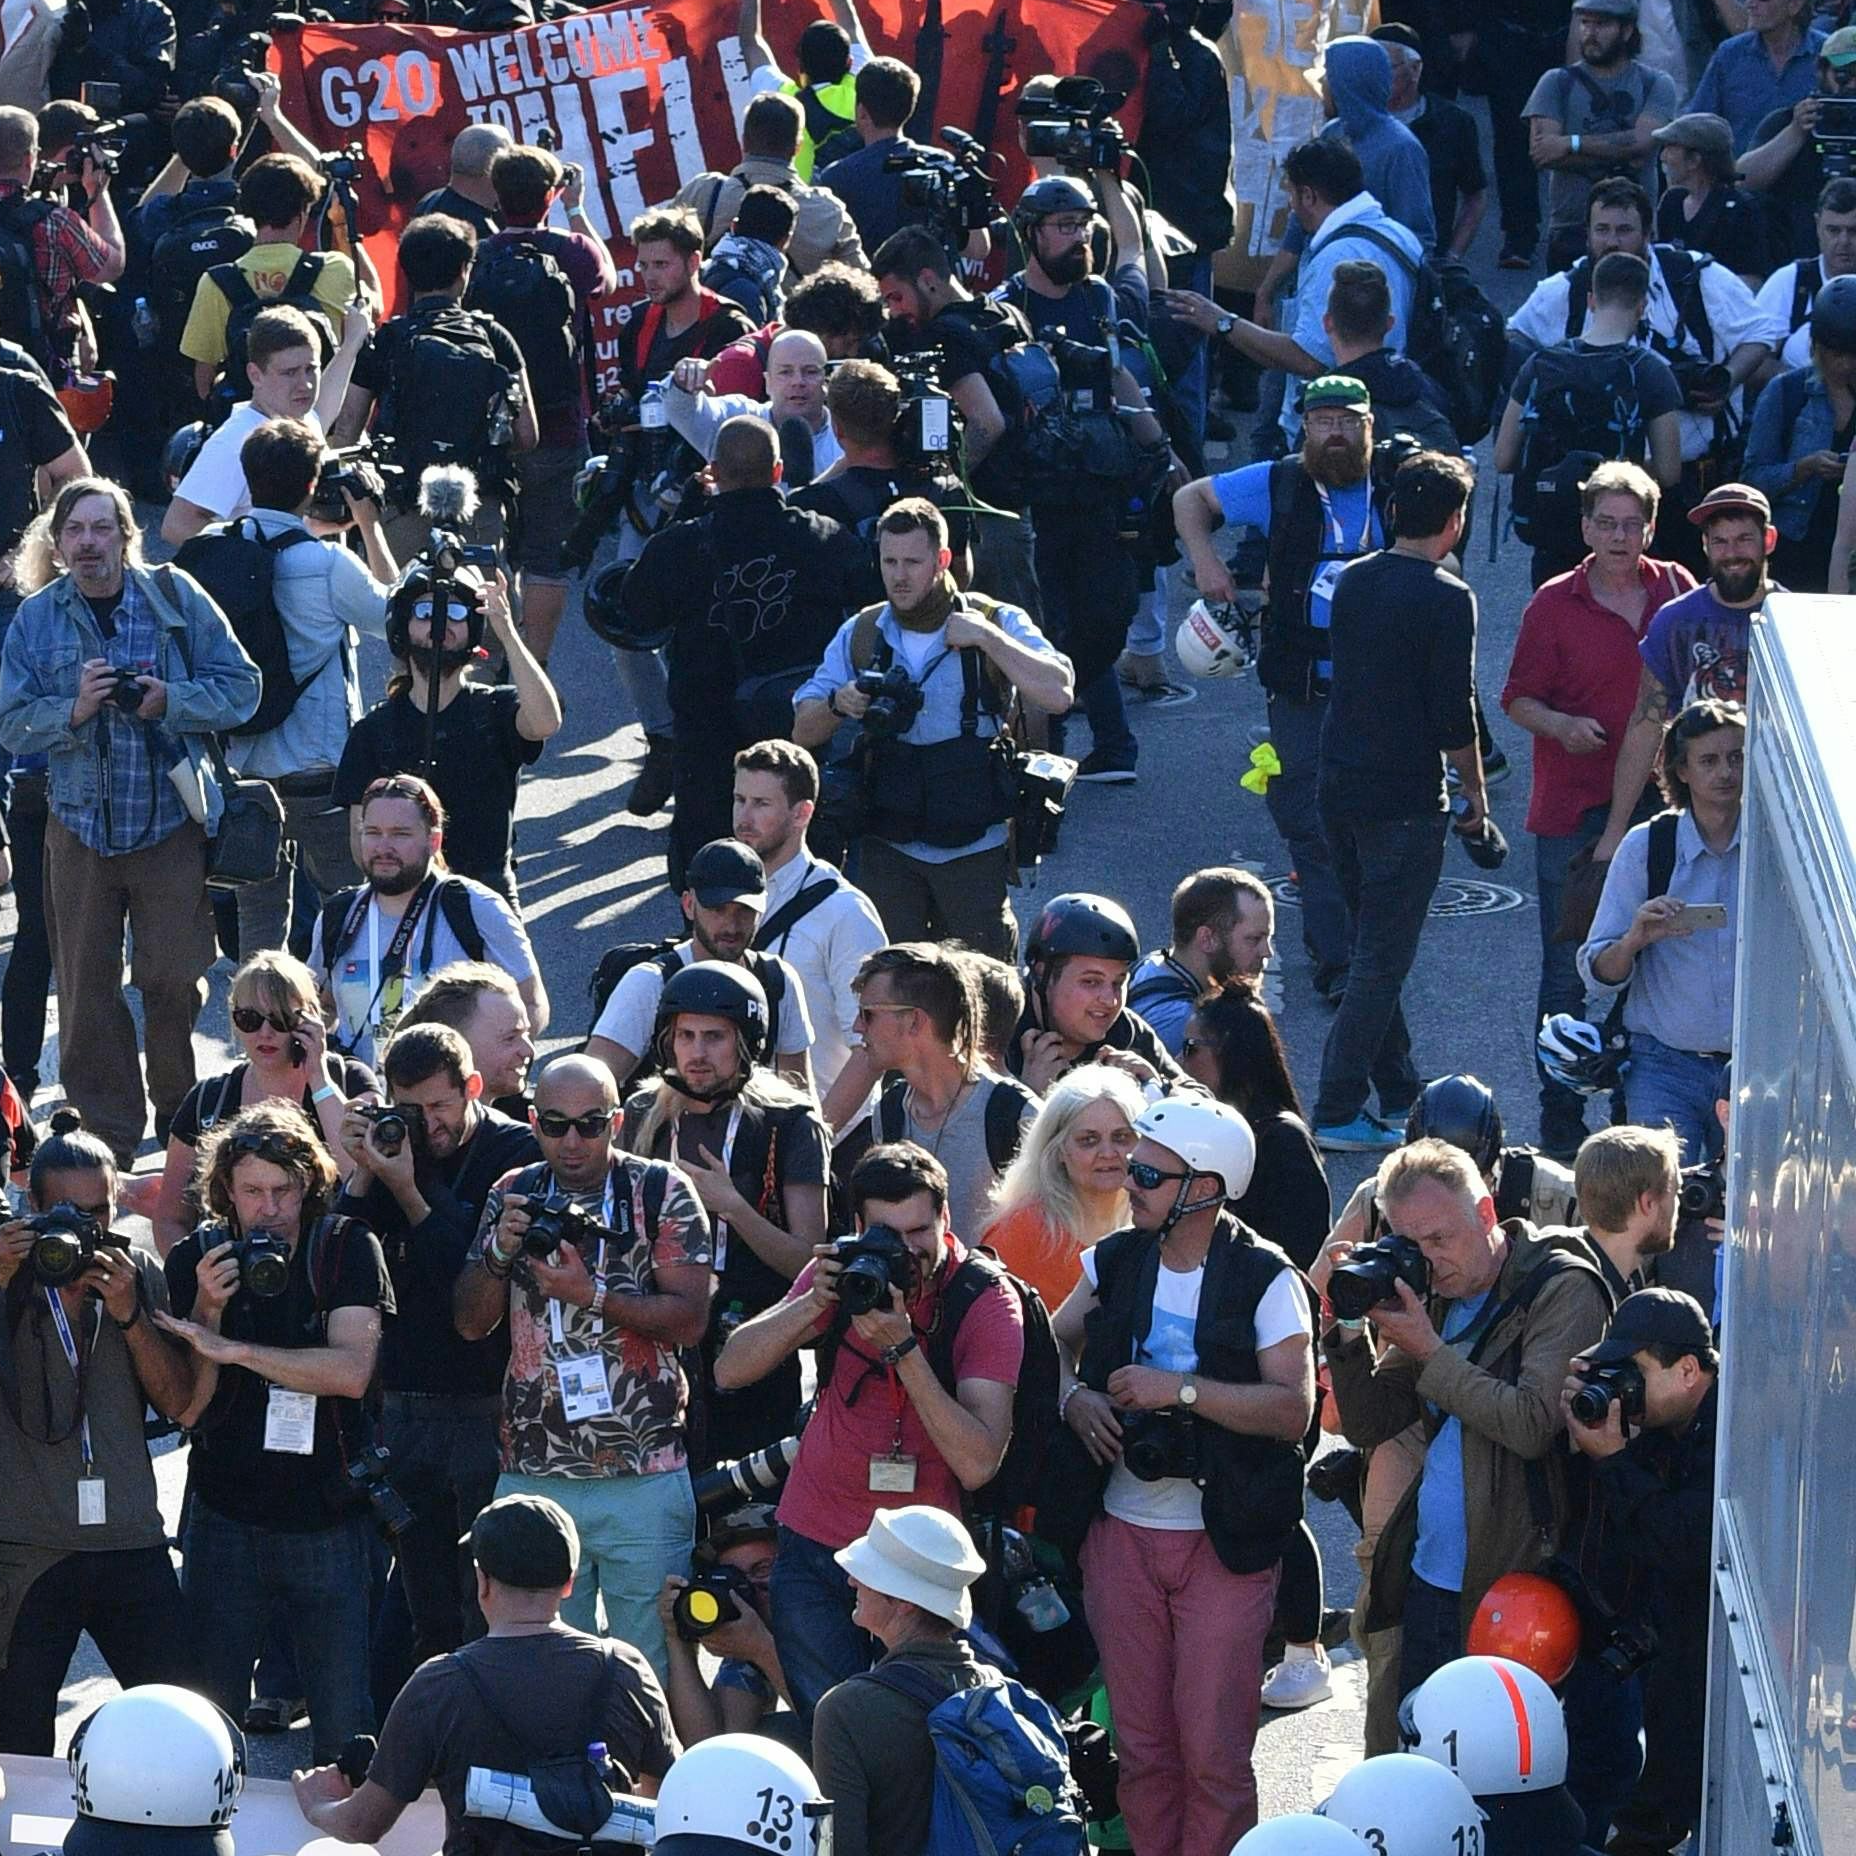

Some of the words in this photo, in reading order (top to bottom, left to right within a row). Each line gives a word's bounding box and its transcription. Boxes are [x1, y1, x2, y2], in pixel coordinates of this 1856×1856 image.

[320, 49, 437, 129] G20
[446, 5, 659, 100] WELCOME
[754, 1787, 794, 1832] 13
